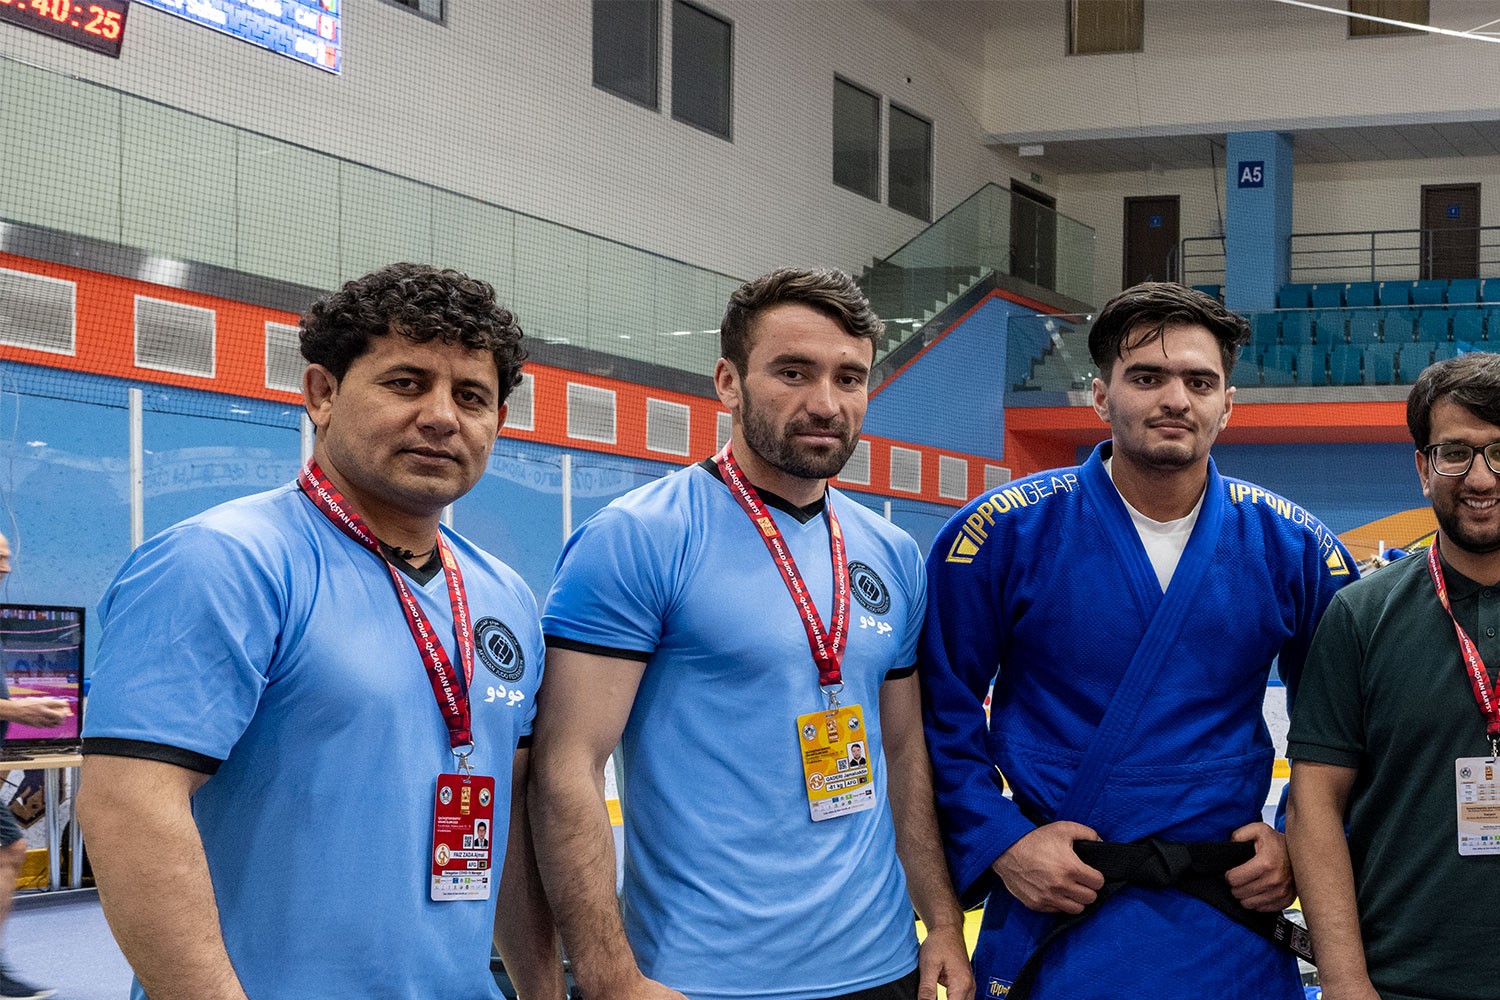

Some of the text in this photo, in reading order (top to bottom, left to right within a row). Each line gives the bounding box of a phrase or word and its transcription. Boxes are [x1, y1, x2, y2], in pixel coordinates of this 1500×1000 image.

[1241, 166, 1262, 183] A5
[317, 487, 349, 523] QAZAQSTAN
[348, 521, 374, 545] BARYSY
[725, 462, 747, 497] QAZAQSTAN
[744, 495, 762, 516] BARYSY
[1229, 482, 1333, 559] IPPONGEAR
[772, 538, 786, 560] WORLD
[782, 560, 794, 577] JUDO
[790, 576, 802, 594] TOUR
[800, 596, 819, 636] QAZAQSTAN
[815, 635, 829, 660] BARYSY
[838, 560, 847, 596] QAZAQSTAN
[395, 572, 408, 598] WORLD
[406, 598, 418, 617] JUDO
[416, 617, 428, 639] TOUR
[425, 641, 449, 687] QAZAQSTAN
[443, 686, 459, 716] BARYSY
[836, 612, 844, 630] JUDO
[1469, 655, 1485, 692] QAZAQSTAN
[1480, 690, 1493, 714] BARYSY
